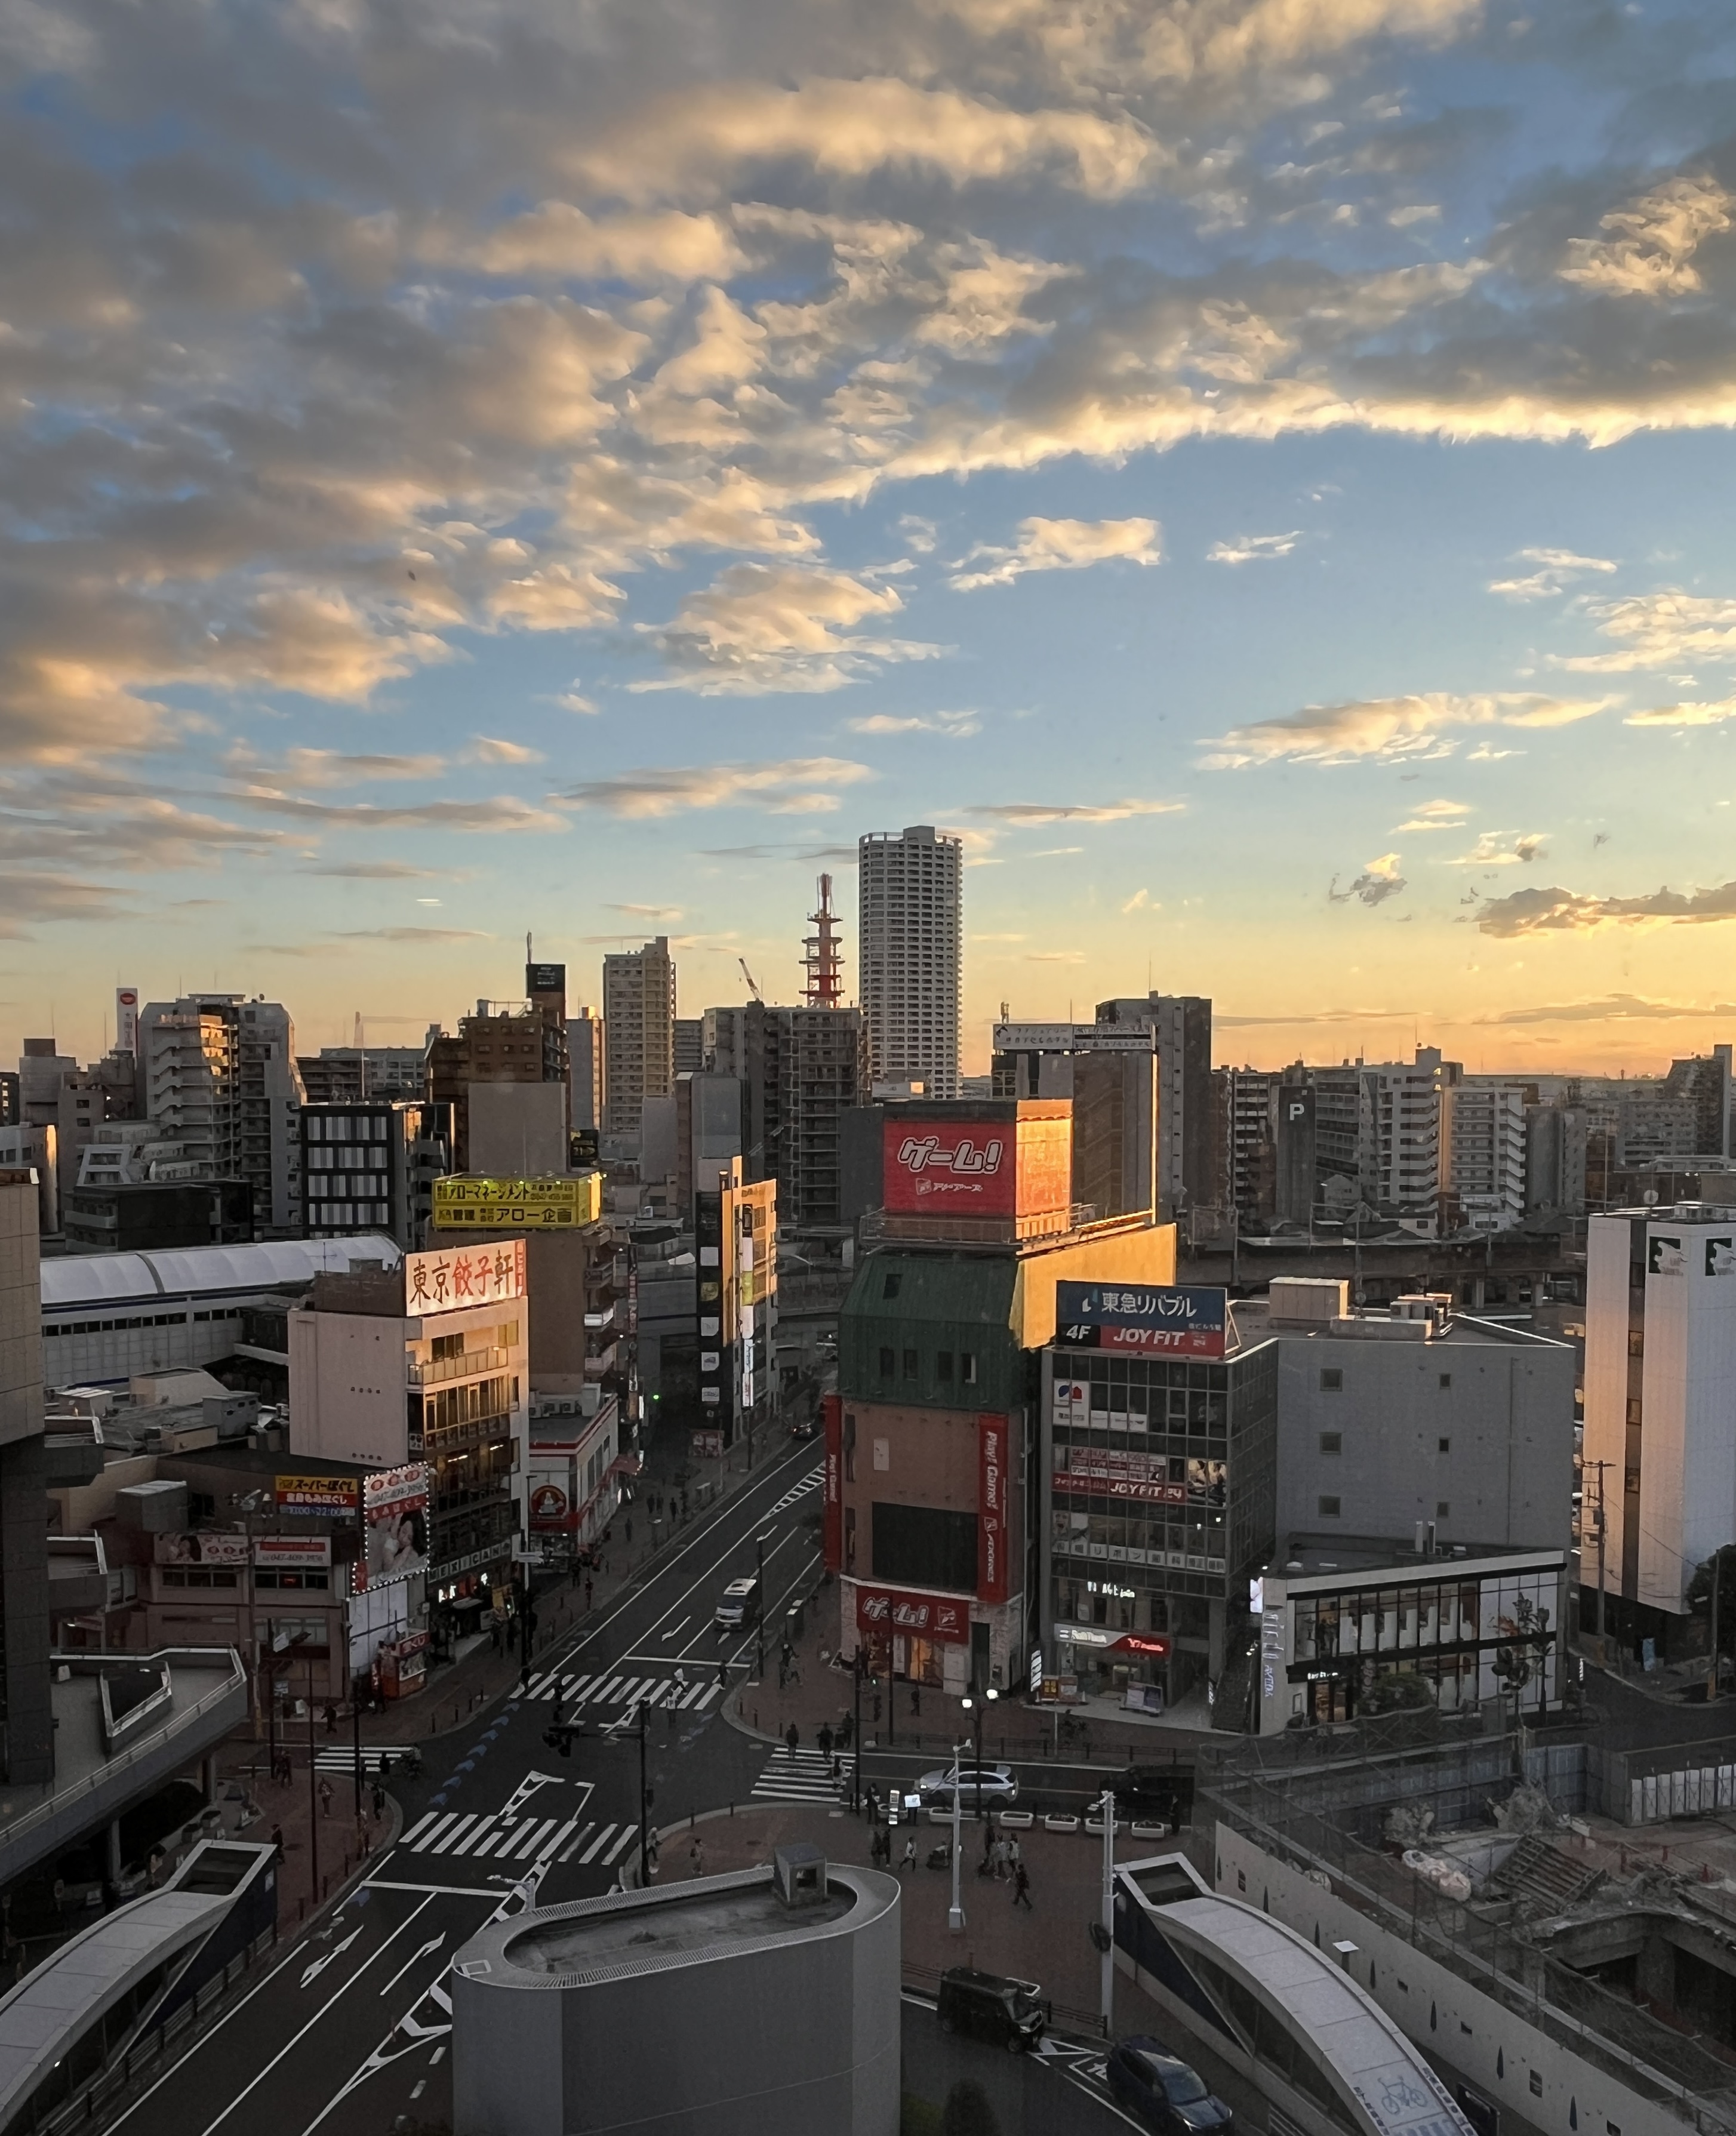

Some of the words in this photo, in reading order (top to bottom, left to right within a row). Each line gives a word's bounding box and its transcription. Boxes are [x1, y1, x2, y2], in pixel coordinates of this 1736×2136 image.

[1289, 1104, 1304, 1121] P
[897, 1135, 1003, 1175] ゲーム!
[409, 1249, 514, 1309] 東京餃子軒
[1101, 1292, 1198, 1318] 東急リバブル
[1066, 1324, 1091, 1340] 4F
